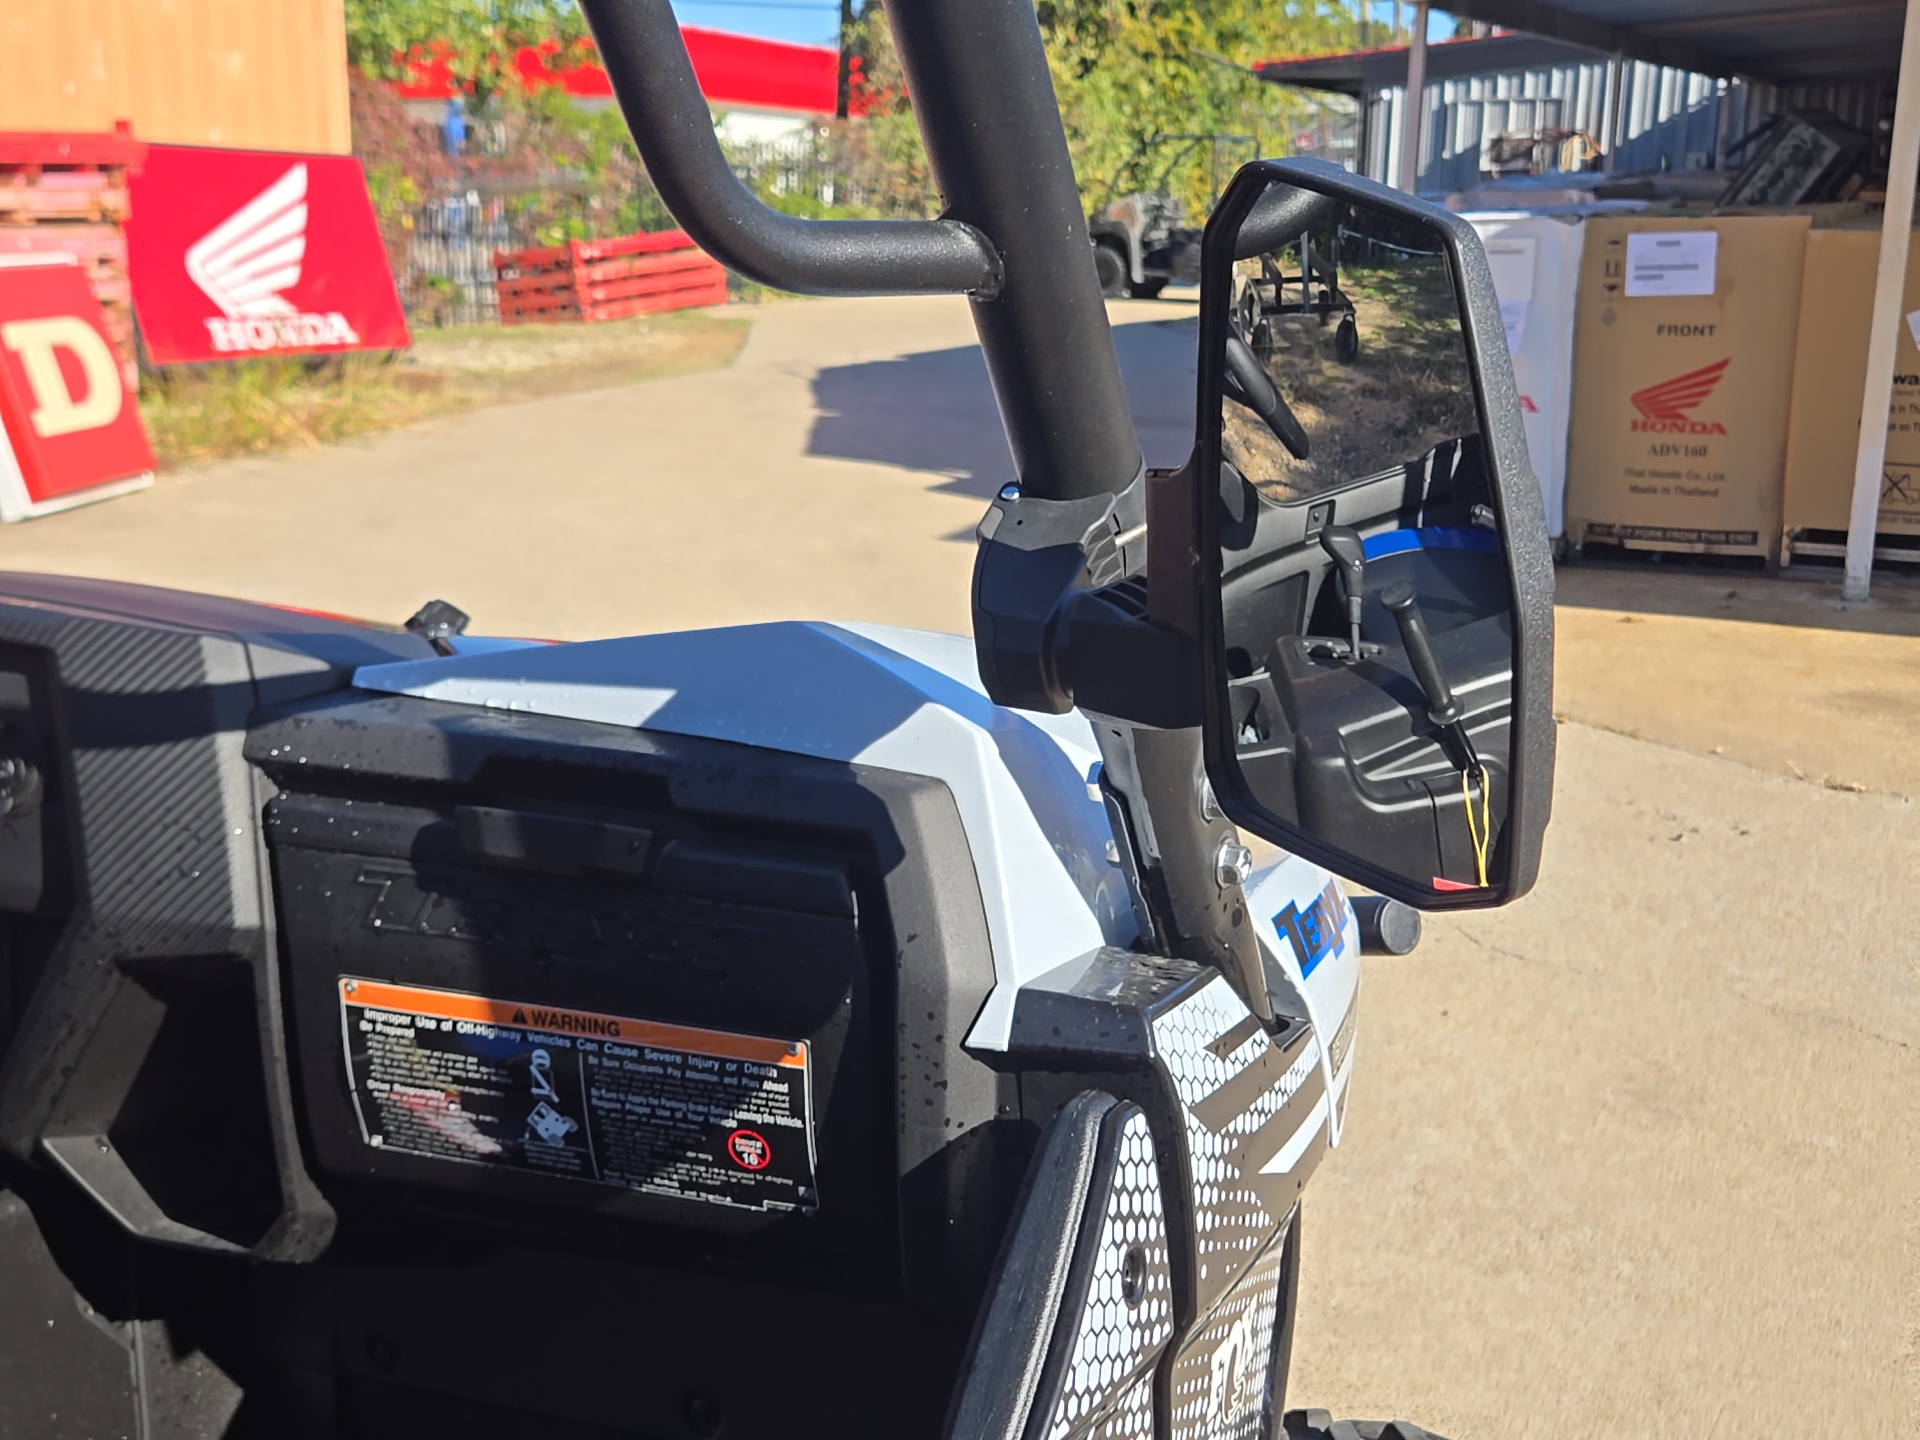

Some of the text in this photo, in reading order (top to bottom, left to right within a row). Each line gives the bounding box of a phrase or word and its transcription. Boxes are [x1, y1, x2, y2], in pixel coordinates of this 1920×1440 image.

[204, 312, 360, 352] HONDA
[1656, 324, 1717, 338] FRONT
[4, 316, 122, 439] D
[1629, 419, 1728, 436] HONDA
[1648, 444, 1708, 458] ADV160
[1647, 468, 1682, 480] Honda
[1629, 484, 1719, 498] Made in Thailand
[1666, 530, 1698, 542] FROM
[1729, 534, 1753, 544] END
[531, 1009, 621, 1037] WARNING
[364, 1008, 412, 1026] Improper
[415, 1015, 437, 1030] Use
[440, 1020, 453, 1032] of
[526, 1031, 571, 1048] Vehicles
[576, 1038, 599, 1051] Can
[604, 1042, 639, 1058] Cause
[644, 1048, 682, 1064] Severe
[688, 1055, 719, 1072] Injury
[726, 1061, 738, 1072] or
[744, 1063, 777, 1078] Death
[667, 1066, 681, 1079] Pay
[742, 1153, 758, 1166] 16
